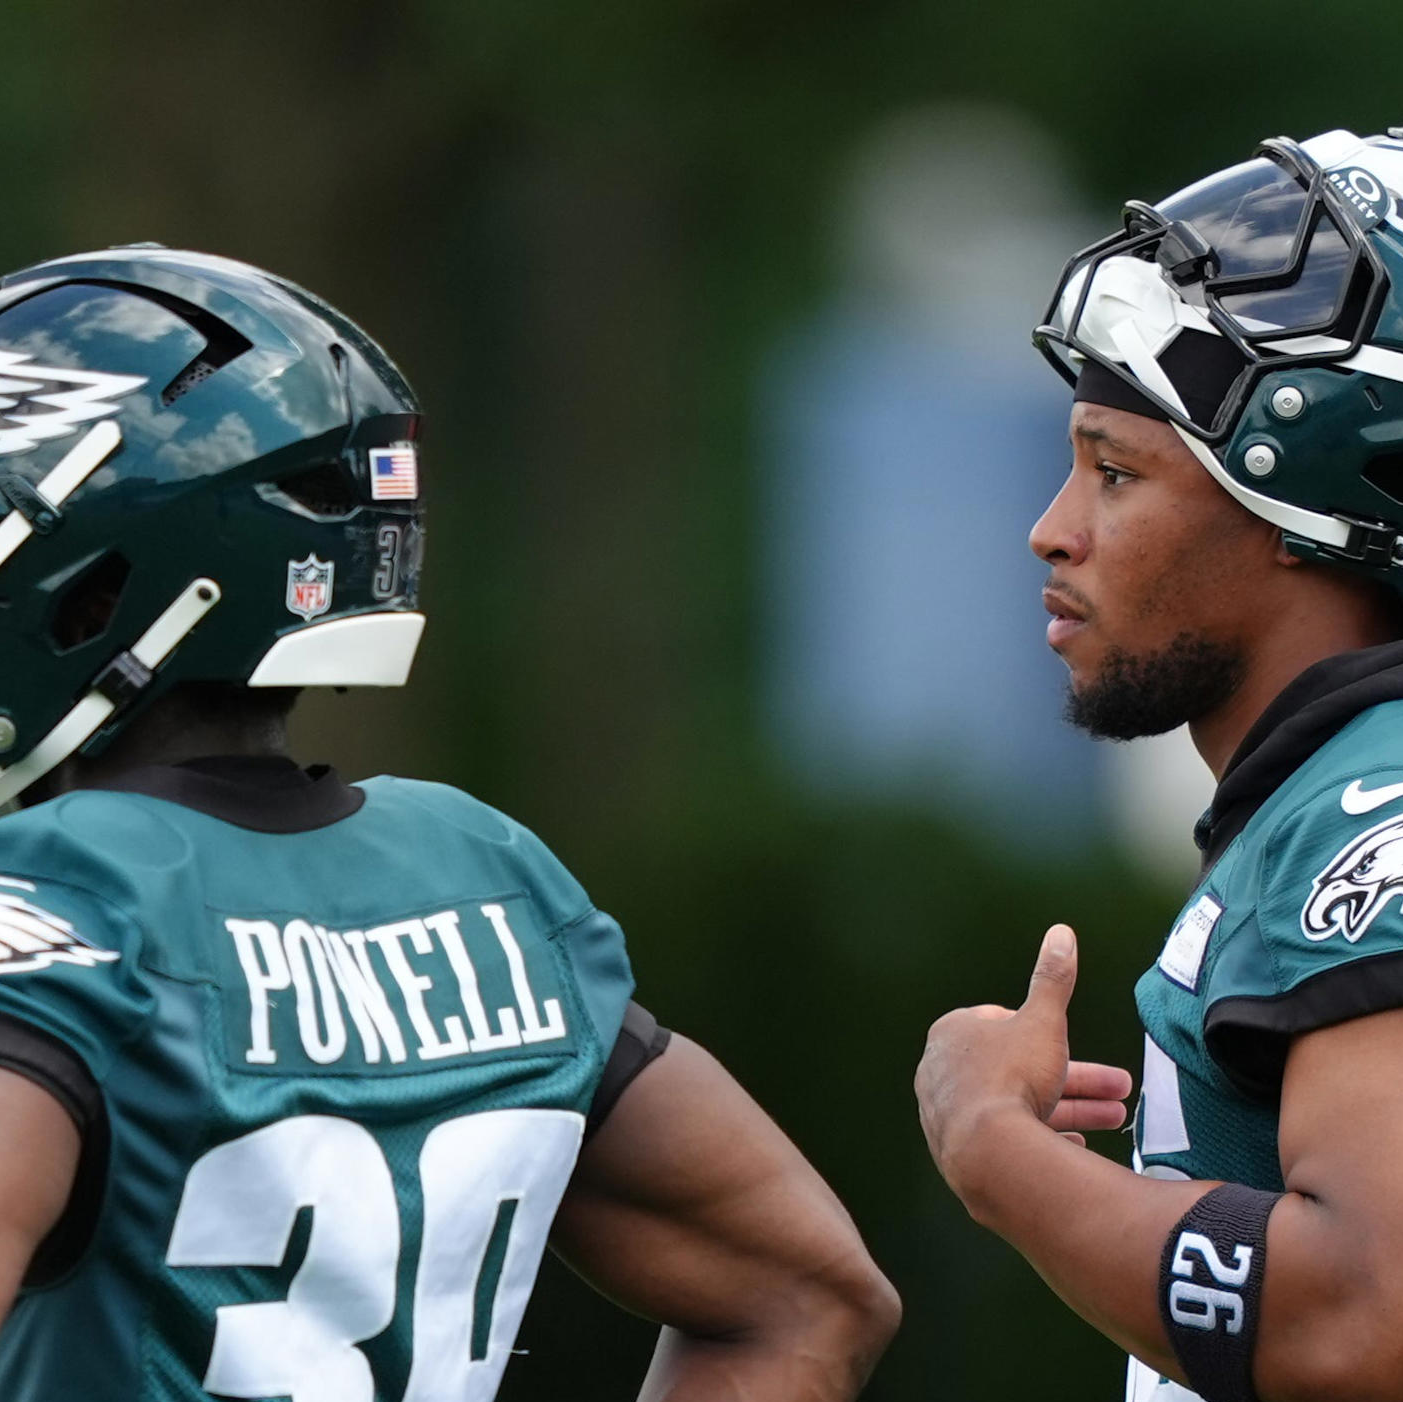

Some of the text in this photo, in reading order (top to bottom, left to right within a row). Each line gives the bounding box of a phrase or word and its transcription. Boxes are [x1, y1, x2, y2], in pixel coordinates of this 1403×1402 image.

[1329, 173, 1378, 219] OAKLEY
[225, 904, 566, 1064] POWELL
[1170, 1230, 1254, 1336] 26
